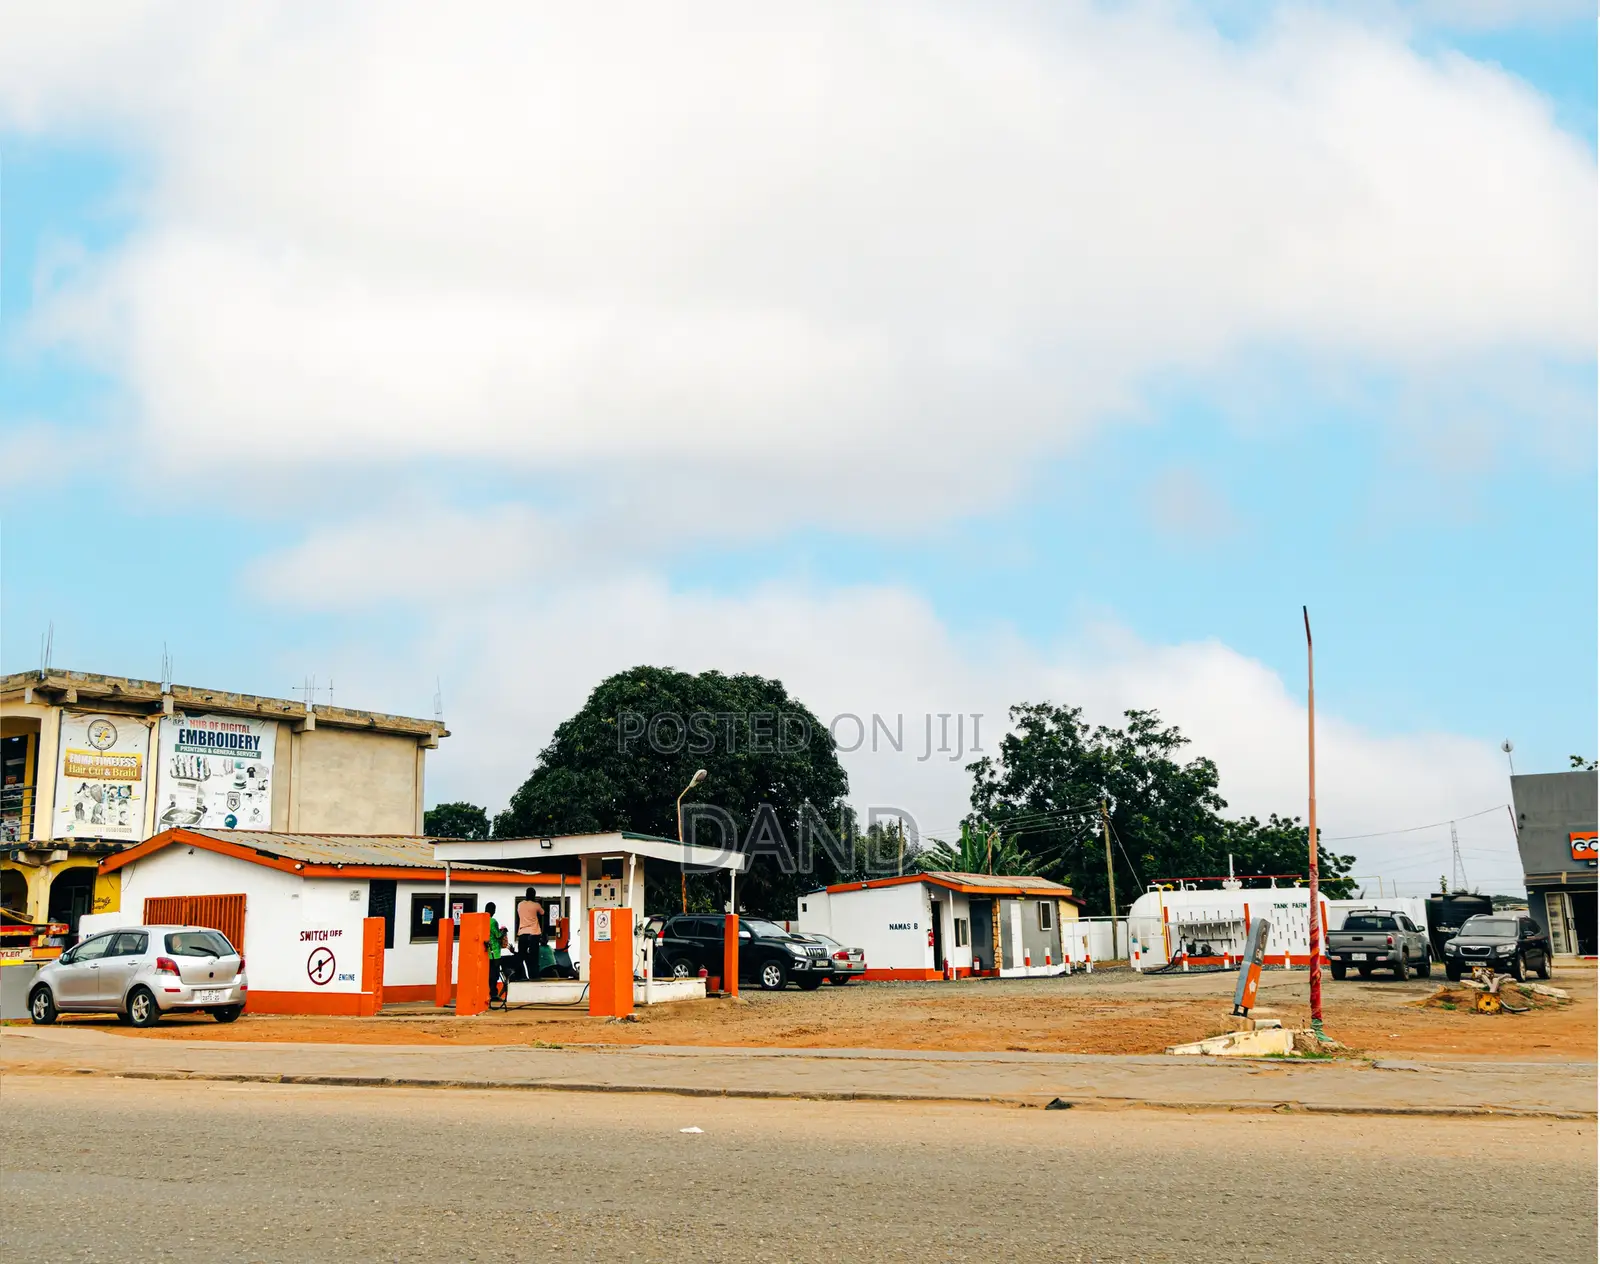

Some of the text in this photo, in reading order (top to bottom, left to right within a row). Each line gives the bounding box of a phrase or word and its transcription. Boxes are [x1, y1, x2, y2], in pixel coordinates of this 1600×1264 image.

[188, 719, 207, 729] HUB
[209, 721, 220, 731] OF
[221, 723, 251, 734] DIGITAL
[178, 728, 261, 751] EMBROIDERY
[180, 745, 207, 754] PRINTING
[213, 748, 236, 757] GENERAL
[236, 750, 258, 758] SERVICE
[95, 755, 137, 768] TIMELESS
[69, 764, 137, 777] Hair Cut & Braid
[300, 930, 328, 941] SWITCH
